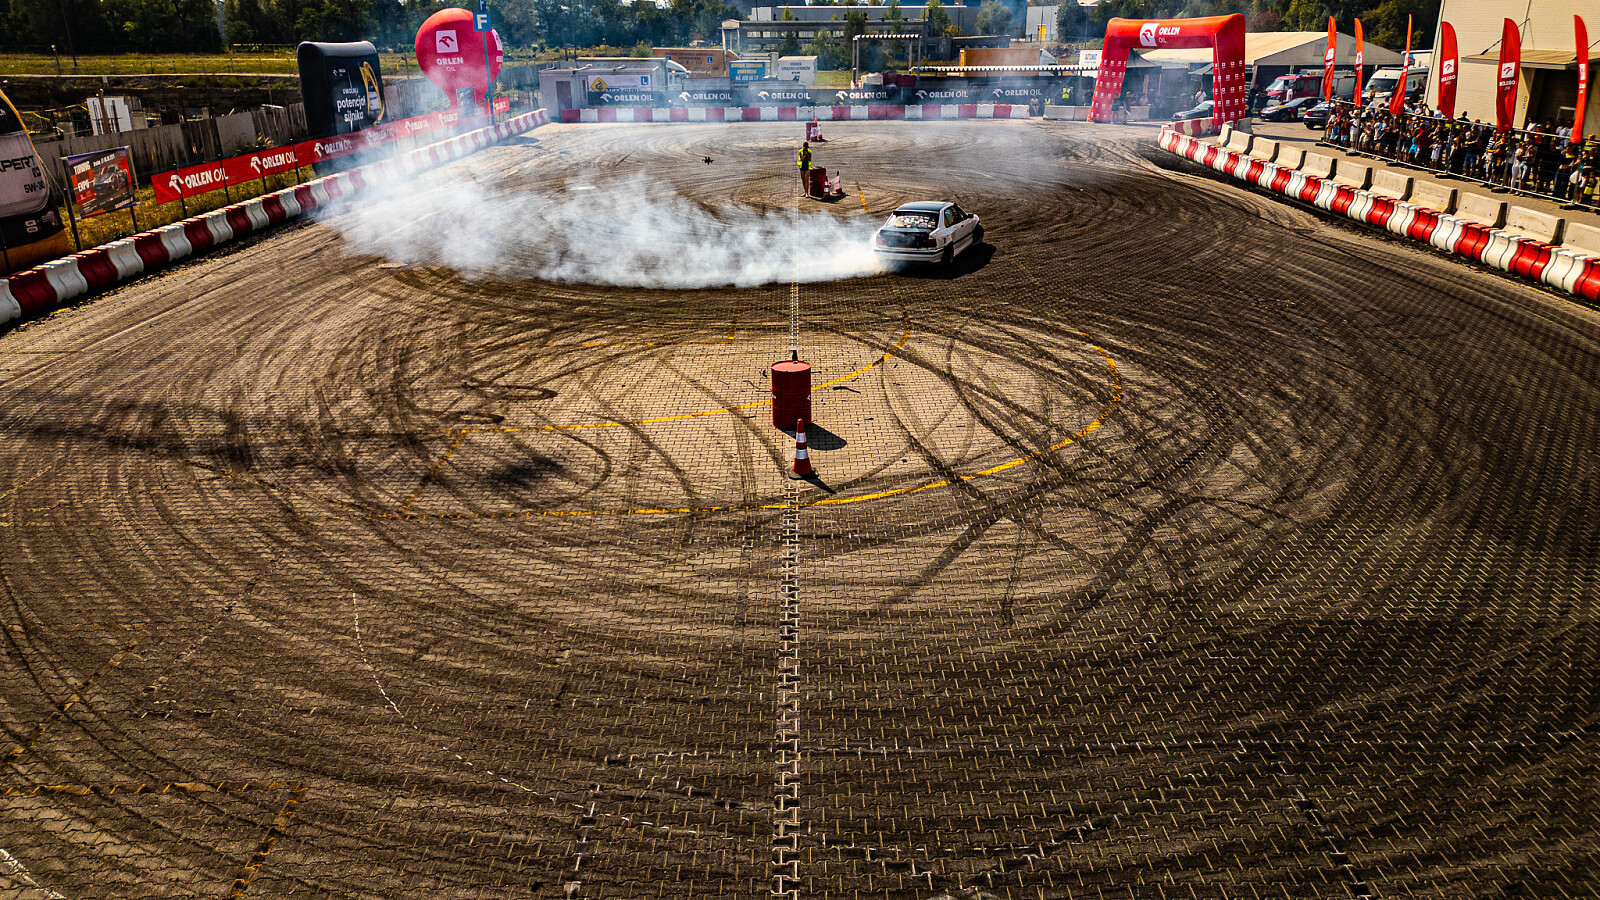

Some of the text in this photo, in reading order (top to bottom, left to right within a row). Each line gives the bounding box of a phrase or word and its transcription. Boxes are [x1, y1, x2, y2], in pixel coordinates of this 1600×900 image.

[476, 14, 488, 29] F
[1158, 26, 1181, 35] ORLEN
[436, 56, 464, 65] ORLEN
[797, 92, 811, 100] OIL
[875, 91, 888, 99] OIL
[955, 90, 969, 98] OIL
[324, 140, 344, 154] ORLEN
[262, 151, 298, 169] ORLEN OIL
[184, 167, 229, 189] ORLEN OIL
[23, 180, 46, 193] 5W-30
